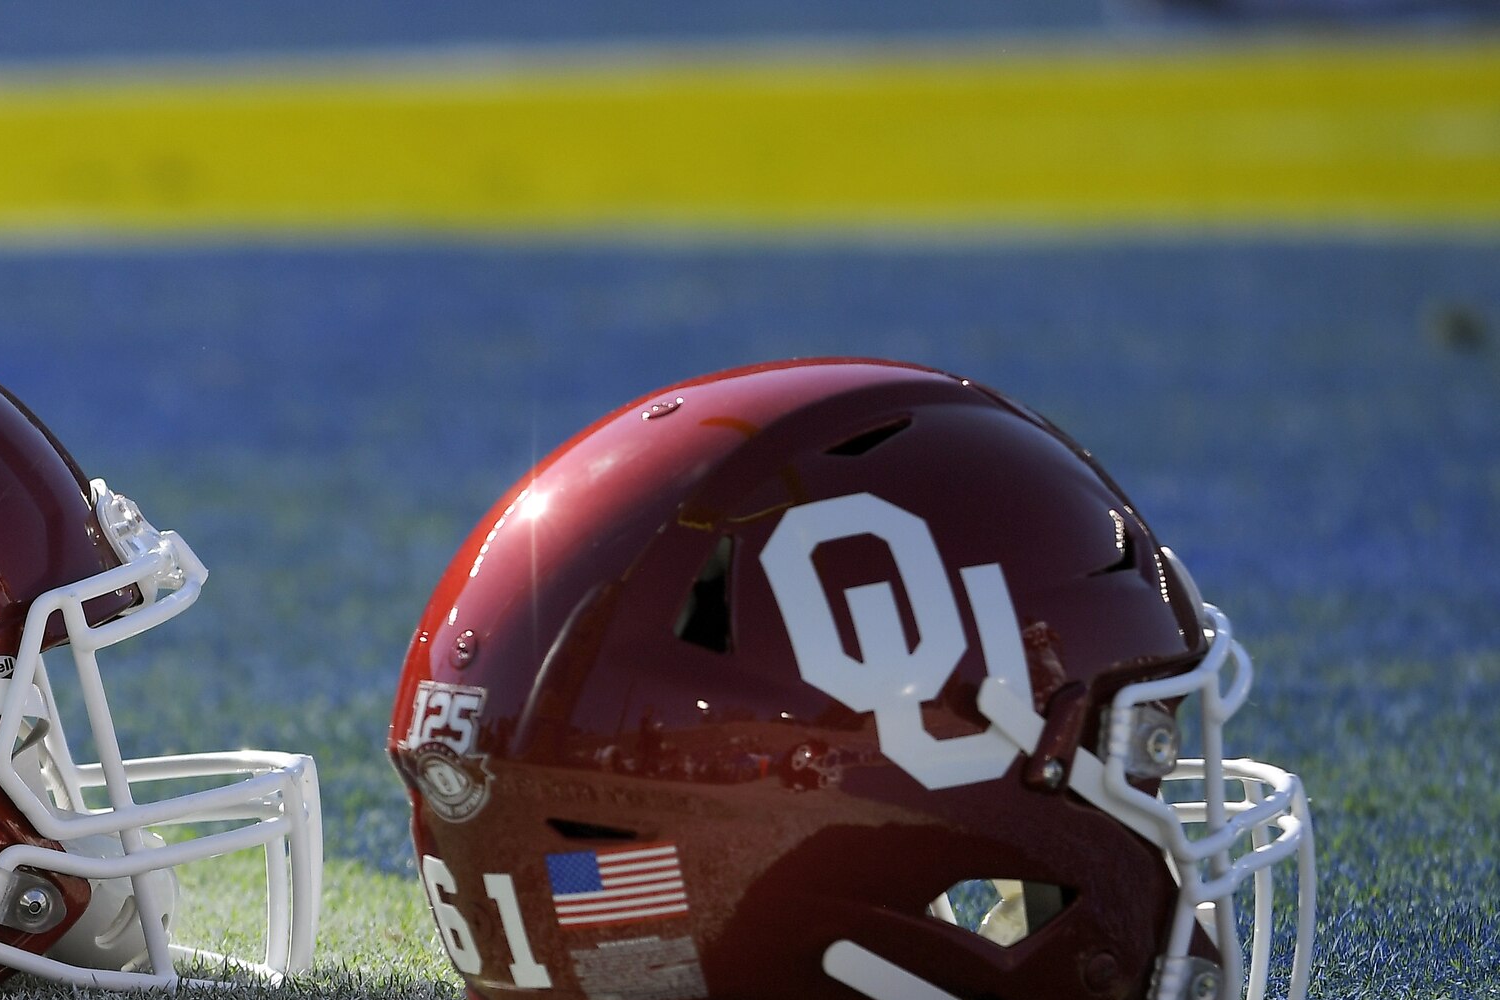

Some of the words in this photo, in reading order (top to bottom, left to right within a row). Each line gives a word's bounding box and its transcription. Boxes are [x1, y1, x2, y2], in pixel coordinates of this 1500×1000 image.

[758, 491, 1033, 791] OU
[408, 689, 480, 755] 125
[422, 854, 553, 989] 61
